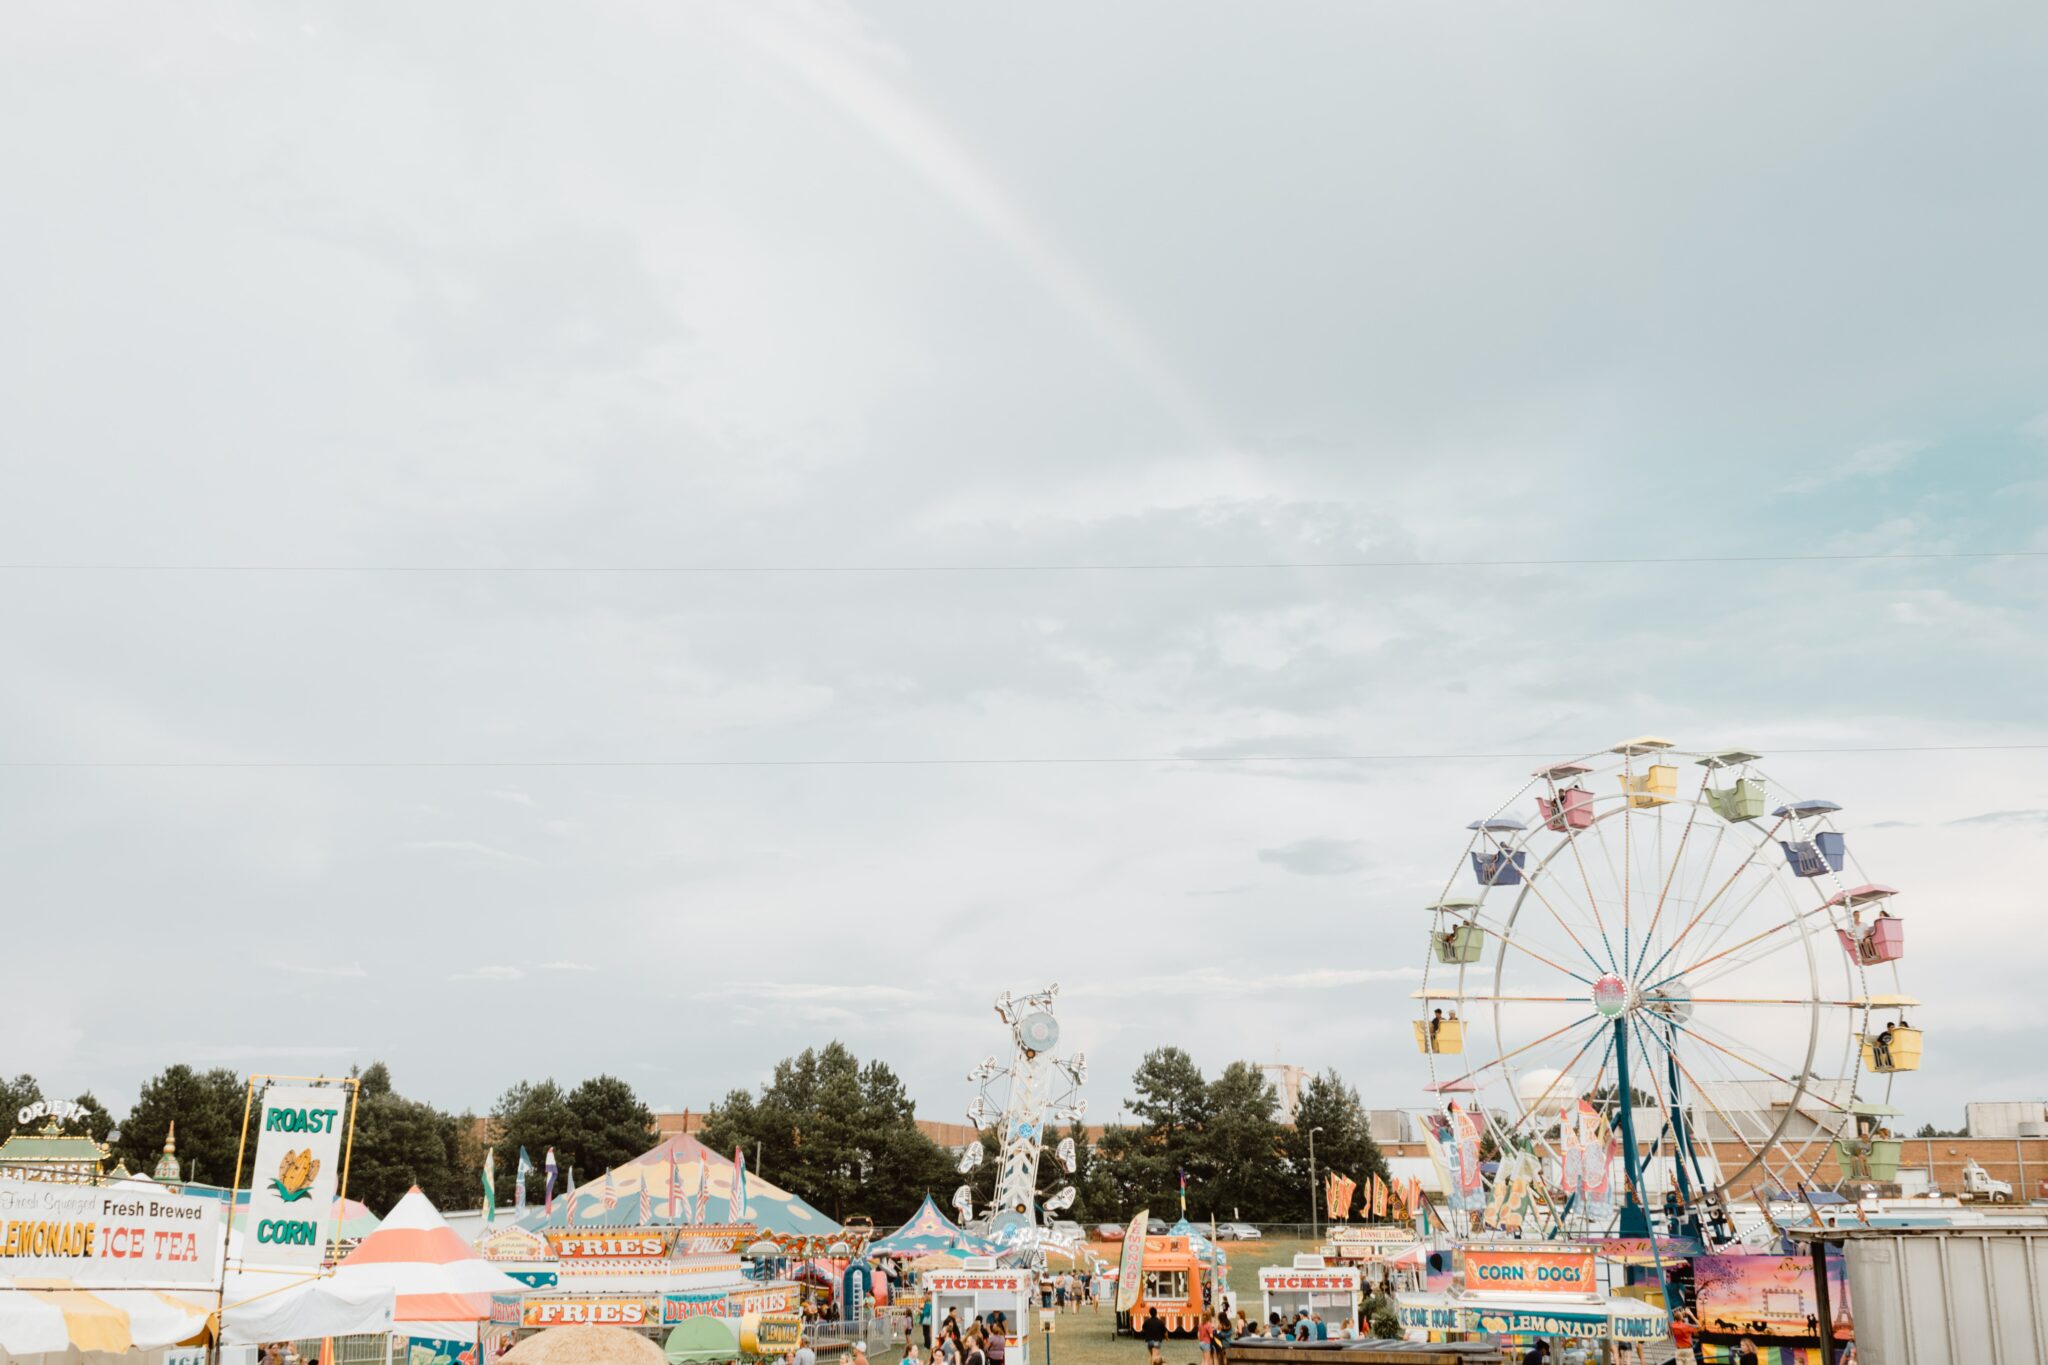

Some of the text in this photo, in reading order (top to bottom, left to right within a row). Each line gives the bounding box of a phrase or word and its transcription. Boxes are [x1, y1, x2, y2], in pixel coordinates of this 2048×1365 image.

[266, 1107, 338, 1134] ROAST
[103, 1200, 202, 1220] Fresh Brewed
[257, 1219, 317, 1245] CORN
[101, 1227, 199, 1262] ICE TEA
[560, 1239, 663, 1256] FRIES
[688, 1236, 738, 1254] FRIES
[1264, 1277, 1354, 1288] TICKETS
[1478, 1265, 1581, 1282] CORN DOGS
[932, 1279, 1018, 1290] TICKETS
[492, 1301, 521, 1320] DRINKS
[538, 1303, 643, 1323] FRIES
[666, 1298, 727, 1320] DRINKS
[744, 1292, 786, 1314] FRIES
[1431, 1309, 1459, 1328] HOME
[1509, 1315, 1608, 1337] LEMONADE
[1615, 1317, 1653, 1337] FUNNEL
